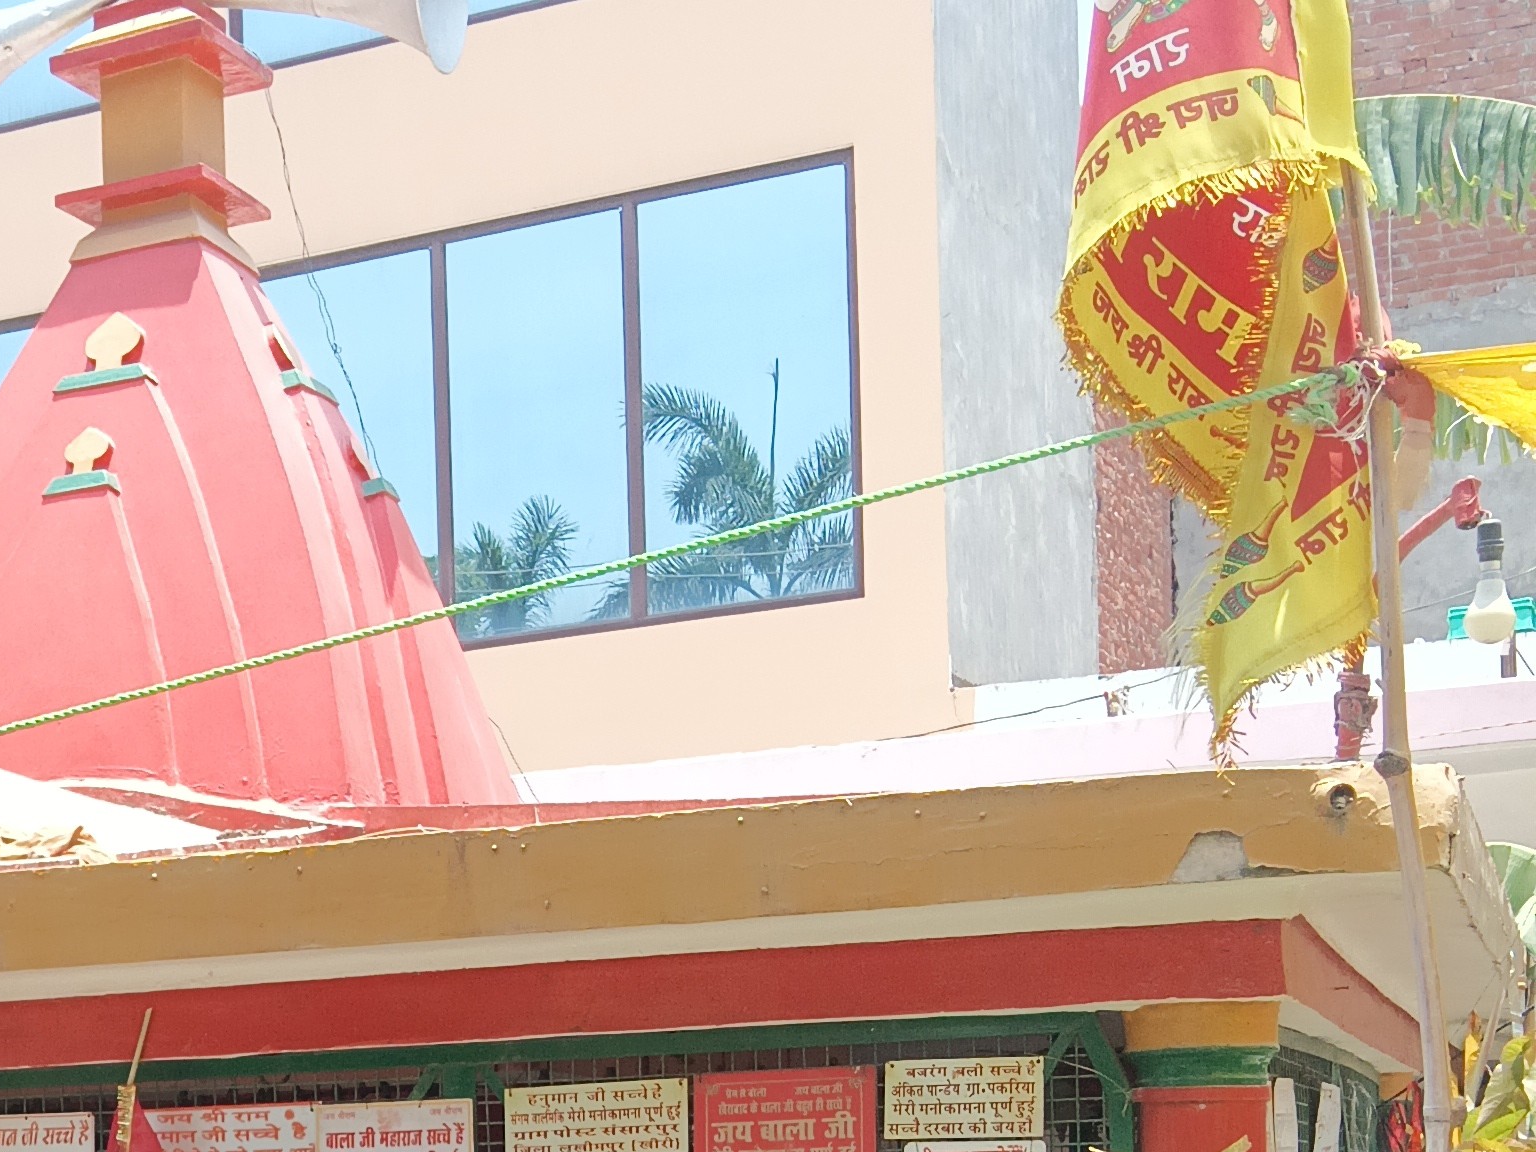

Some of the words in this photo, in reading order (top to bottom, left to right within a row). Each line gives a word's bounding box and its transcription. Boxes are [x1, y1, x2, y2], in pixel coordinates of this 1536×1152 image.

[1093, 281, 1129, 344] जय
[1127, 334, 1165, 374] श्री
[906, 1064, 947, 1078] बजरंग
[954, 1063, 983, 1077] बली
[989, 1061, 1021, 1076] सच्चे
[527, 1092, 578, 1108] हनुमान
[585, 1087, 605, 1103] जी
[612, 1084, 648, 1101] सच्चे
[892, 1082, 923, 1097] अंकित
[927, 1079, 960, 1096] पान्डेय
[157, 1111, 192, 1125] जय
[200, 1108, 227, 1124] श्री
[233, 1110, 270, 1122] राम
[567, 1106, 586, 1122] मेरी
[589, 1105, 641, 1122] मनोकामना
[644, 1102, 663, 1122] पूर्ण
[666, 1101, 682, 1121] हुई
[893, 1099, 915, 1115] मेरी
[919, 1098, 985, 1115] मनोकामना
[989, 1097, 1013, 1117] पूर्ण
[1016, 1096, 1037, 1117] हुई
[22, 1120, 39, 1146] जी
[42, 1120, 75, 1145] सच्चे
[159, 1129, 196, 1143] मान
[202, 1126, 227, 1143] जी
[234, 1124, 280, 1142] सच्चे
[292, 1121, 307, 1140] है
[359, 1126, 375, 1148] जी
[379, 1130, 422, 1148] महाराज
[427, 1122, 450, 1145] सच्चे
[512, 1129, 548, 1141] ग्राम
[553, 1125, 596, 1139] पोस्ट
[711, 1121, 754, 1143] जय
[759, 1118, 816, 1141] बाला
[821, 1111, 856, 1139] जी
[923, 1122, 963, 1135] दरबार
[968, 1118, 987, 1134] की
